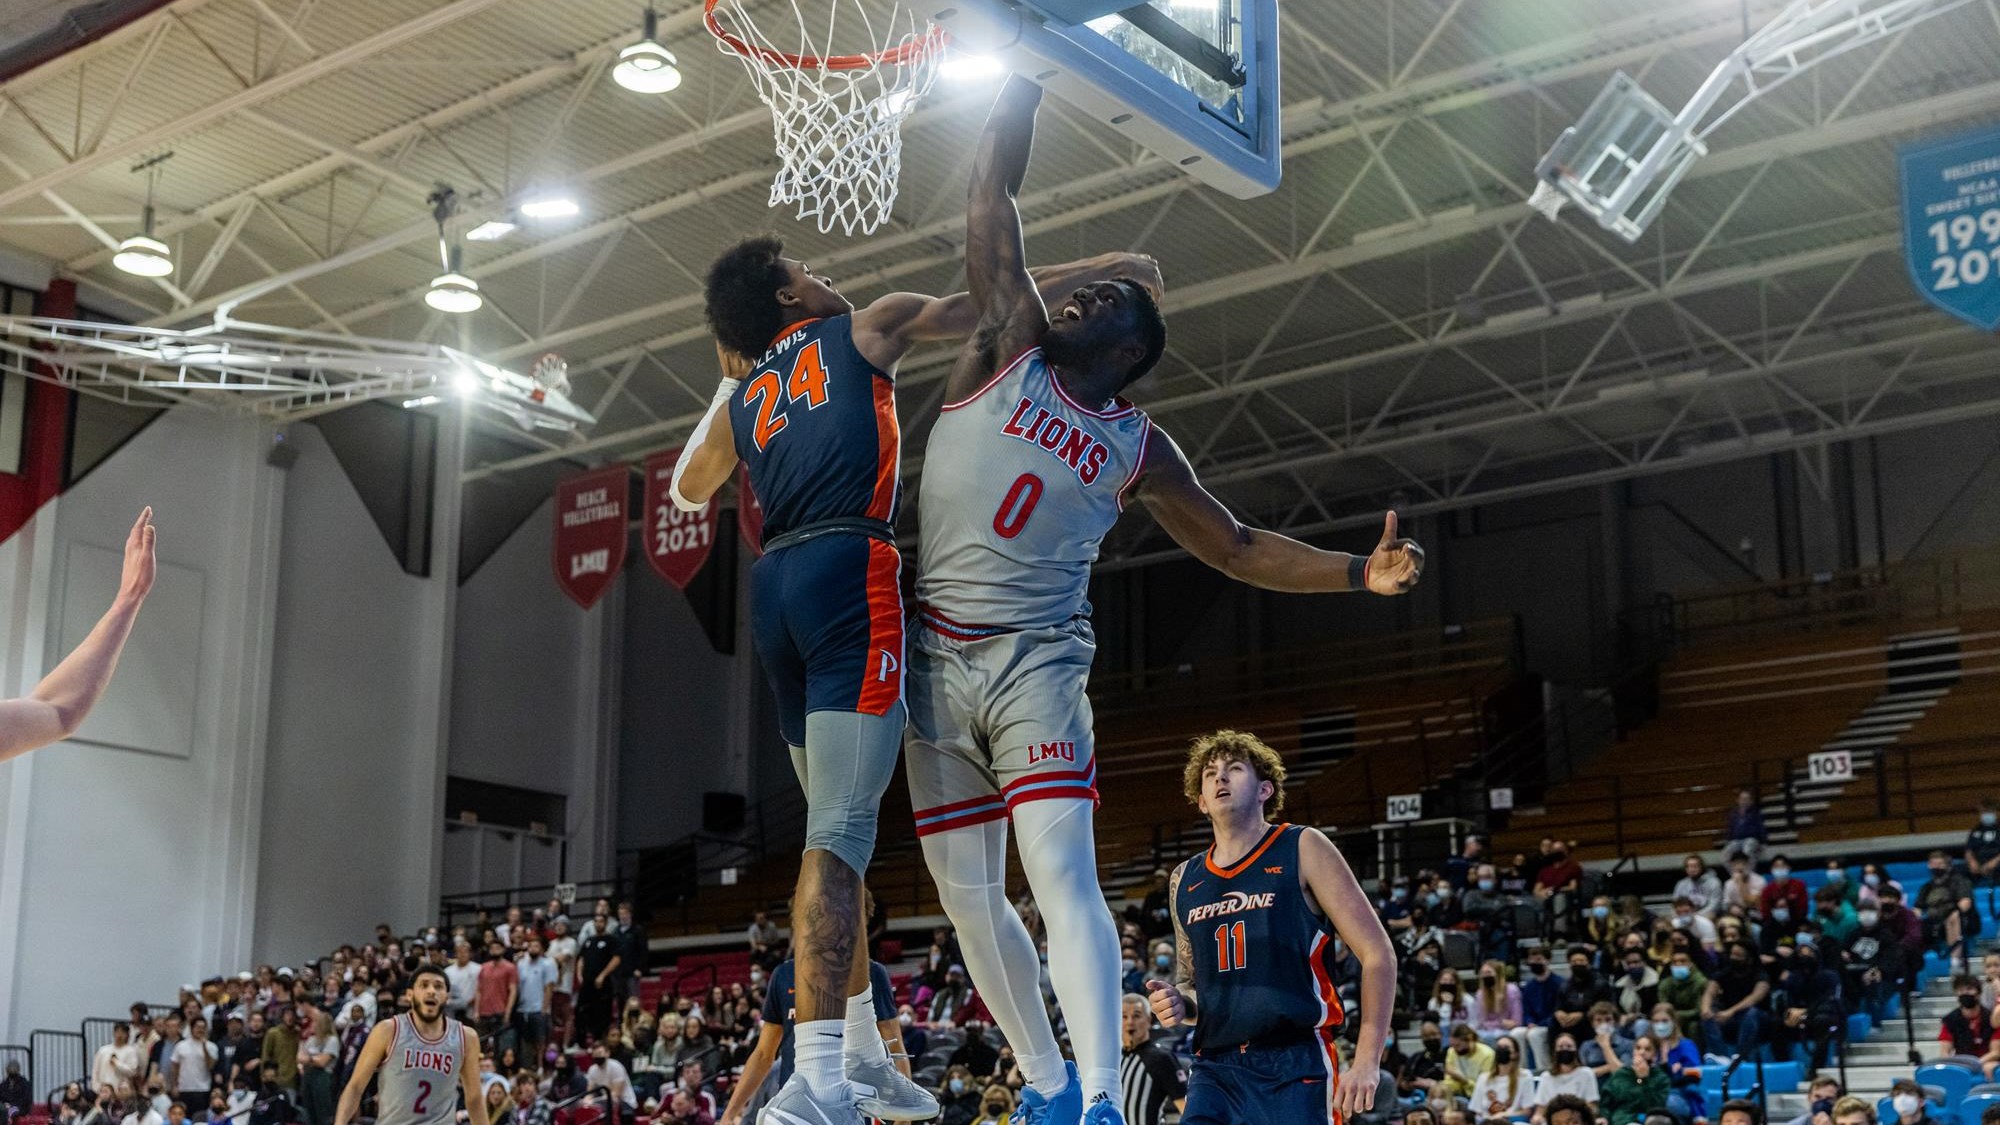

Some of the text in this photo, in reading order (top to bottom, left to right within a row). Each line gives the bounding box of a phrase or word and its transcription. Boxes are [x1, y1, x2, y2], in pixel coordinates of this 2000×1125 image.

[1925, 196, 1970, 217] SWEET
[743, 337, 830, 453] 24
[1000, 396, 1110, 487] LIONS
[992, 472, 1044, 540] 0
[655, 521, 711, 556] 2021
[570, 548, 609, 579] LMU
[1027, 740, 1075, 766] LMU
[1813, 756, 1848, 777] 103
[1388, 798, 1418, 817] 104
[1186, 891, 1275, 926] PEPPERDINE
[1214, 920, 1247, 972] 11
[402, 1048, 454, 1076] LIONS
[413, 1080, 432, 1115] 2
